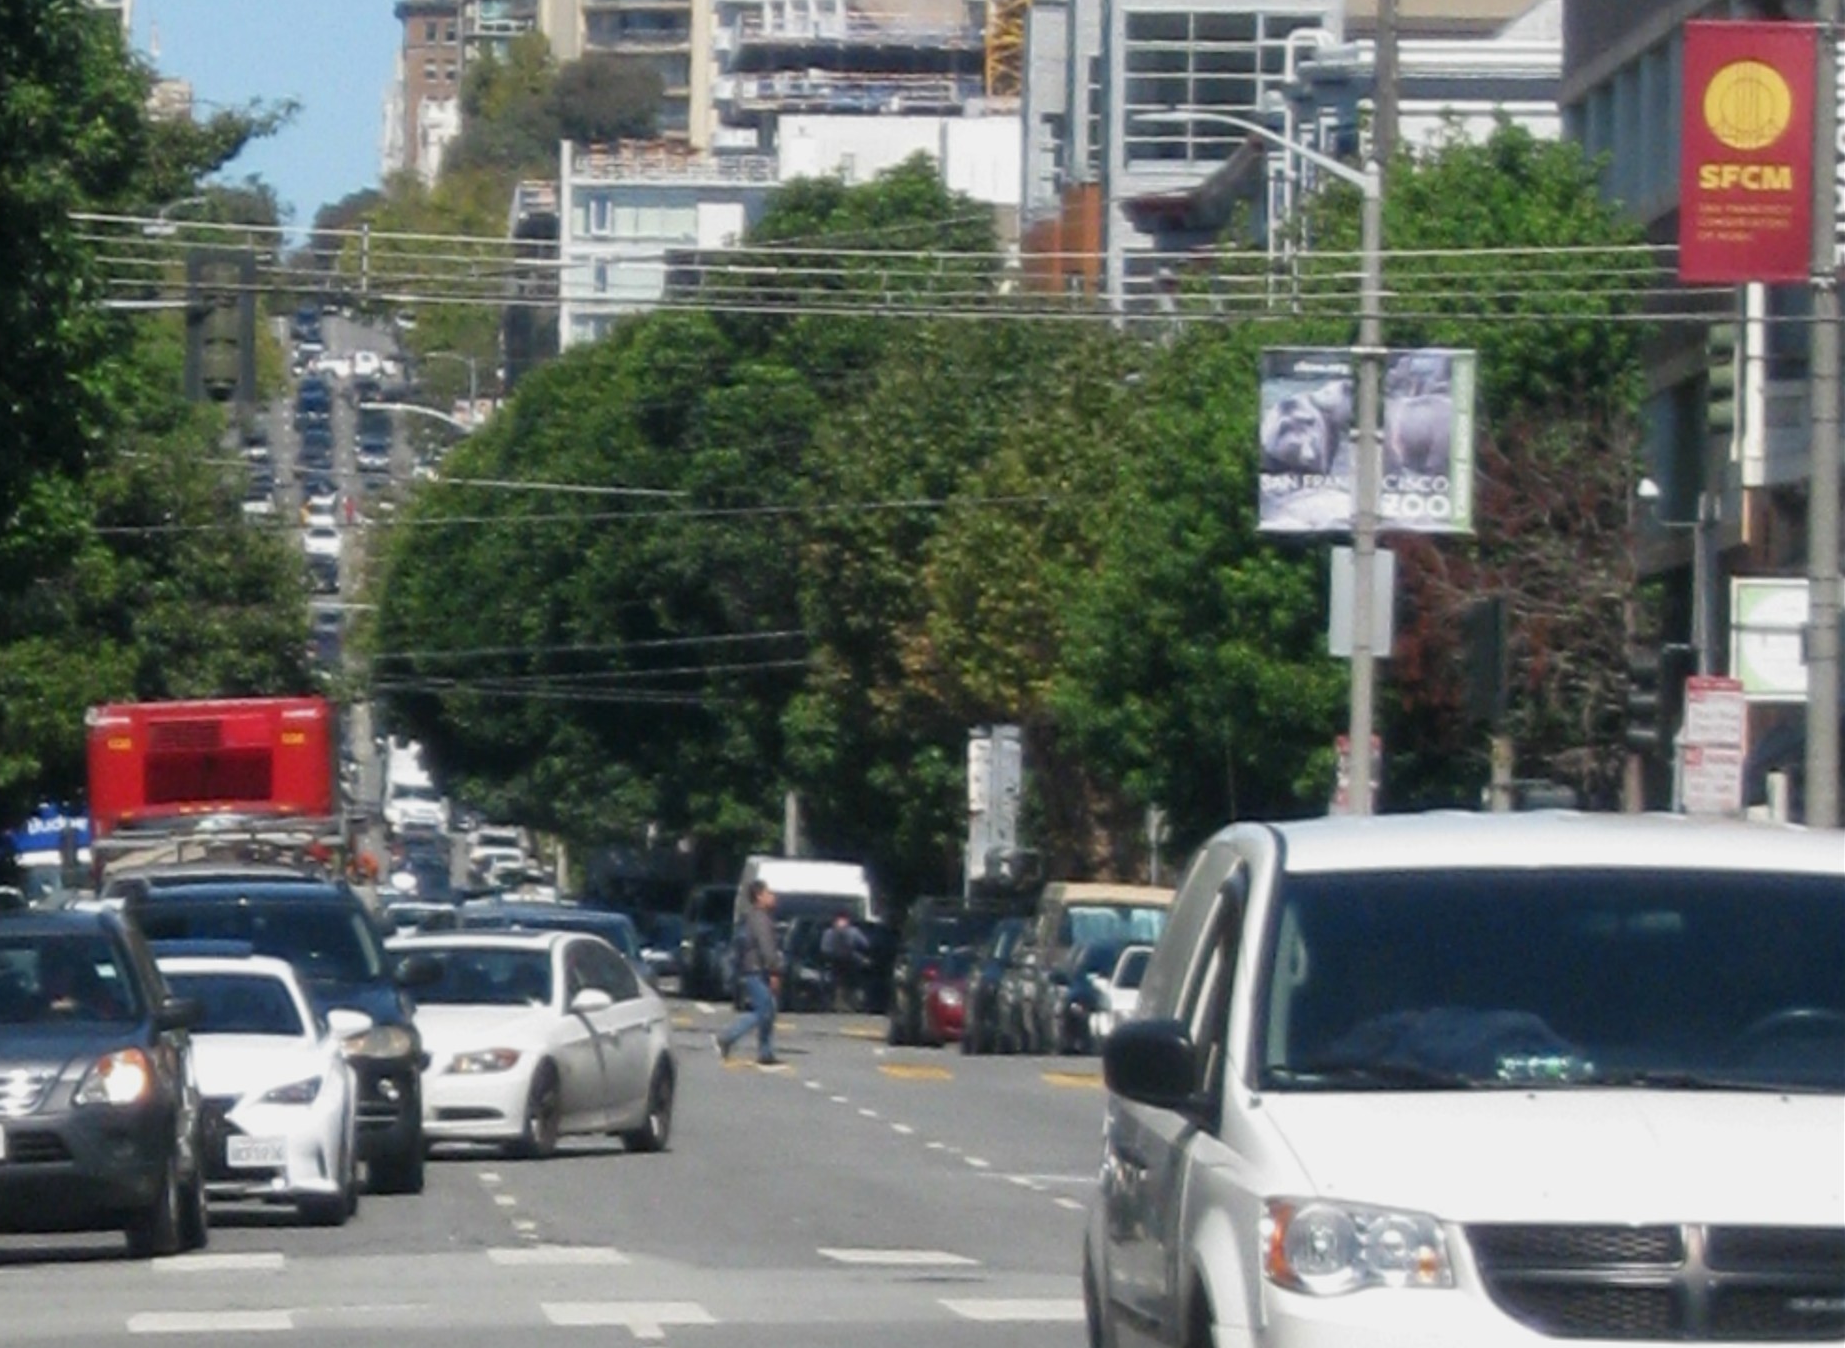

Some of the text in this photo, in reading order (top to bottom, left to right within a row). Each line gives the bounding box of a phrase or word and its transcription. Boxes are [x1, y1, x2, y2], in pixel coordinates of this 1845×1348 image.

[1699, 163, 1793, 190] SFCM
[1260, 473, 1299, 491] SAN
[1381, 492, 1451, 518] ZOO
